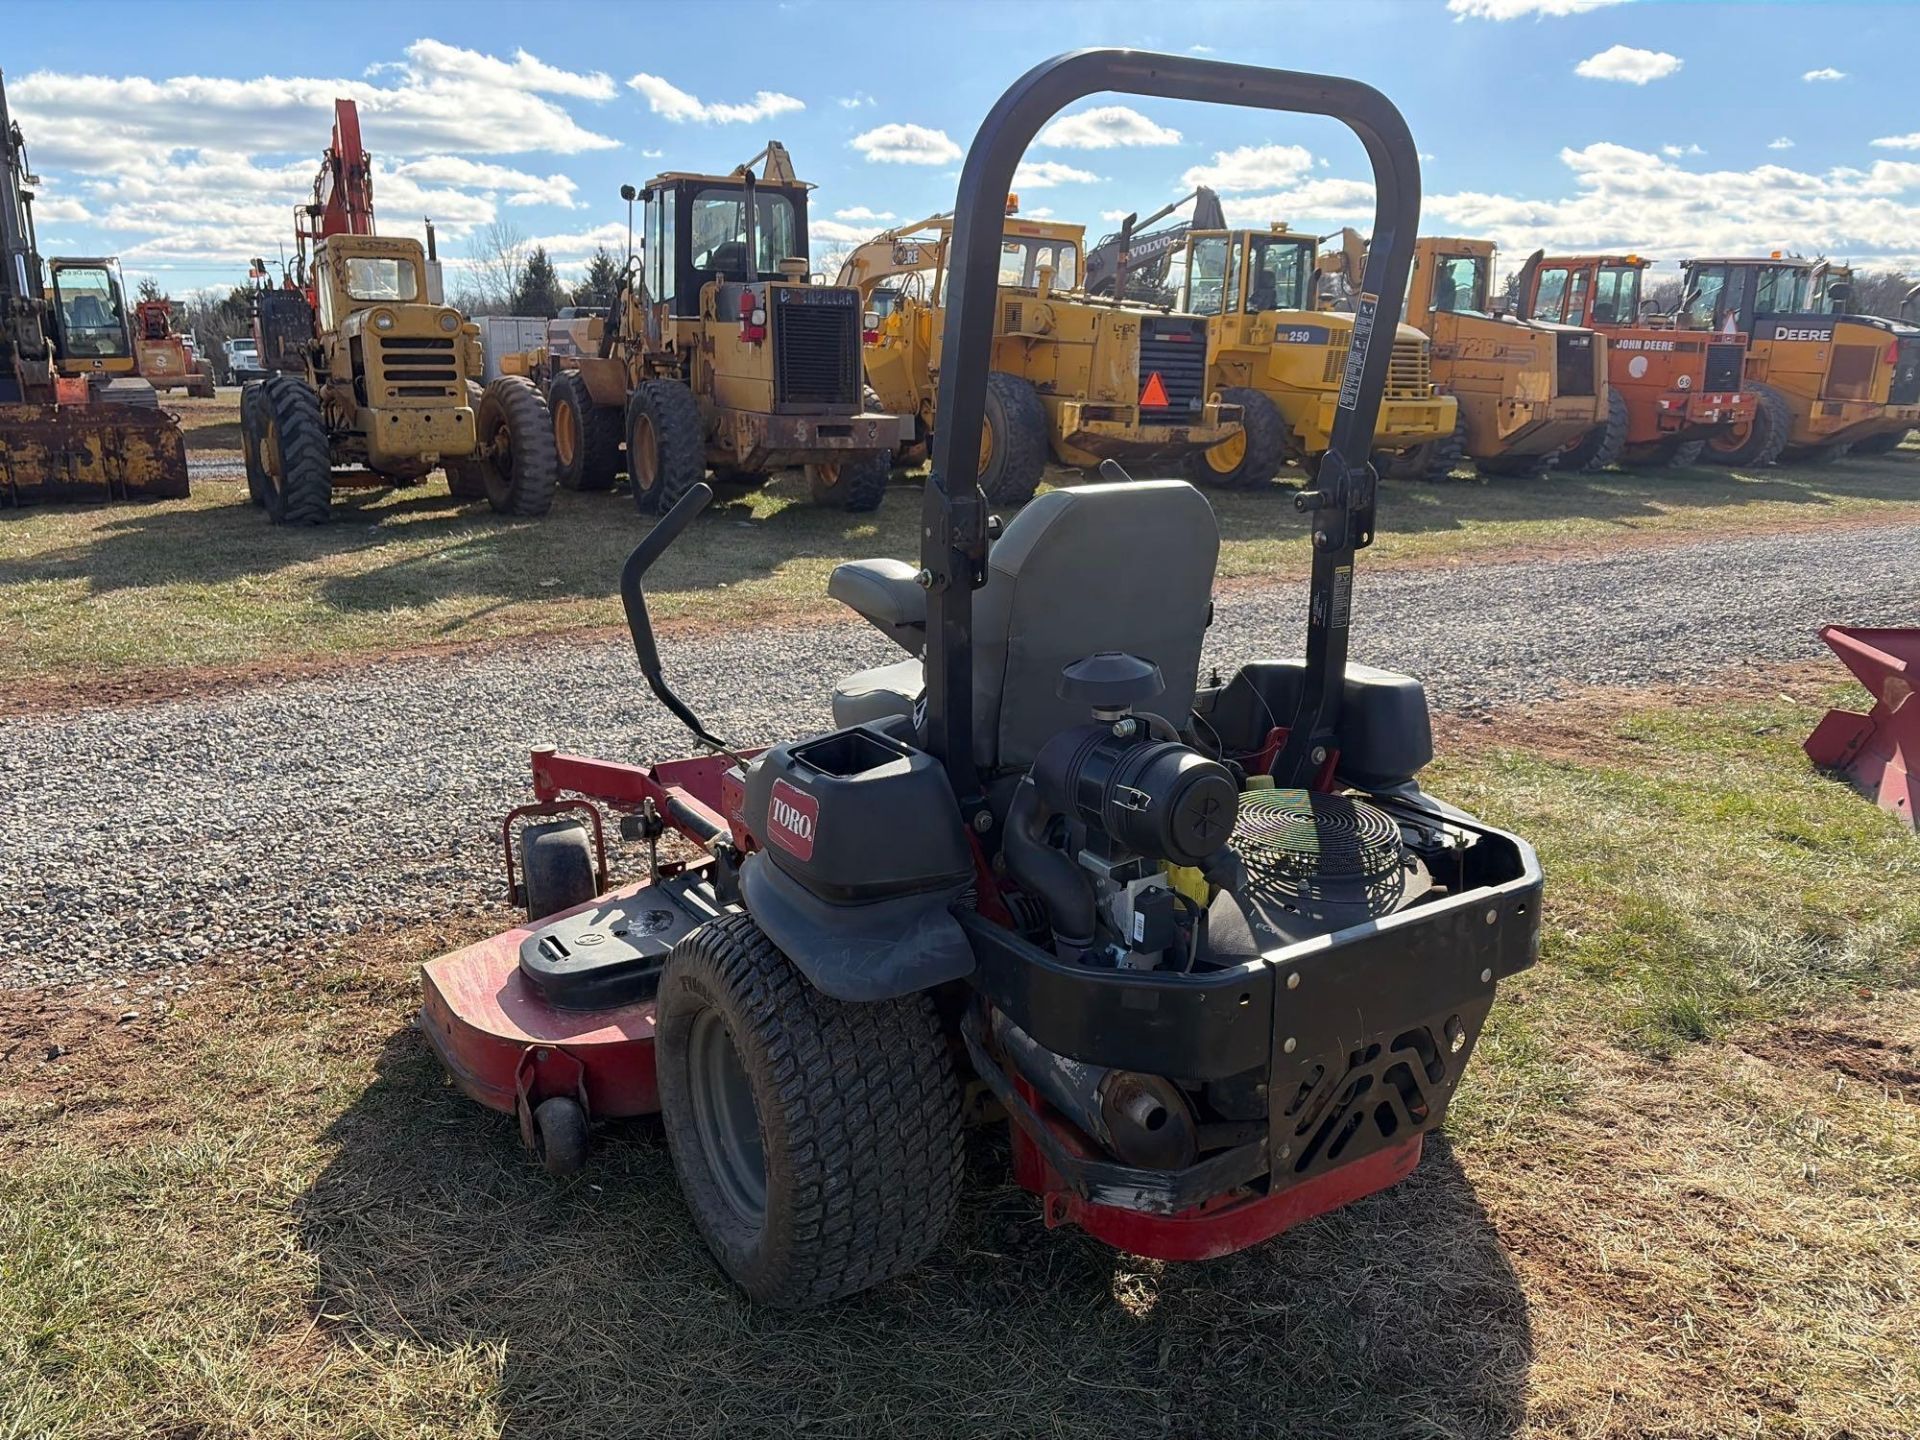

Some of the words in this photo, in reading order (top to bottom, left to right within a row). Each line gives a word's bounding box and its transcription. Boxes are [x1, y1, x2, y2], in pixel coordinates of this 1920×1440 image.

[1129, 236, 1171, 257] VOLVO
[1289, 331, 1310, 342] 250
[1775, 326, 1831, 342] DEERE
[1616, 339, 1642, 349] JOHN
[1643, 340, 1674, 351] DEERE
[772, 797, 812, 839] TORO
